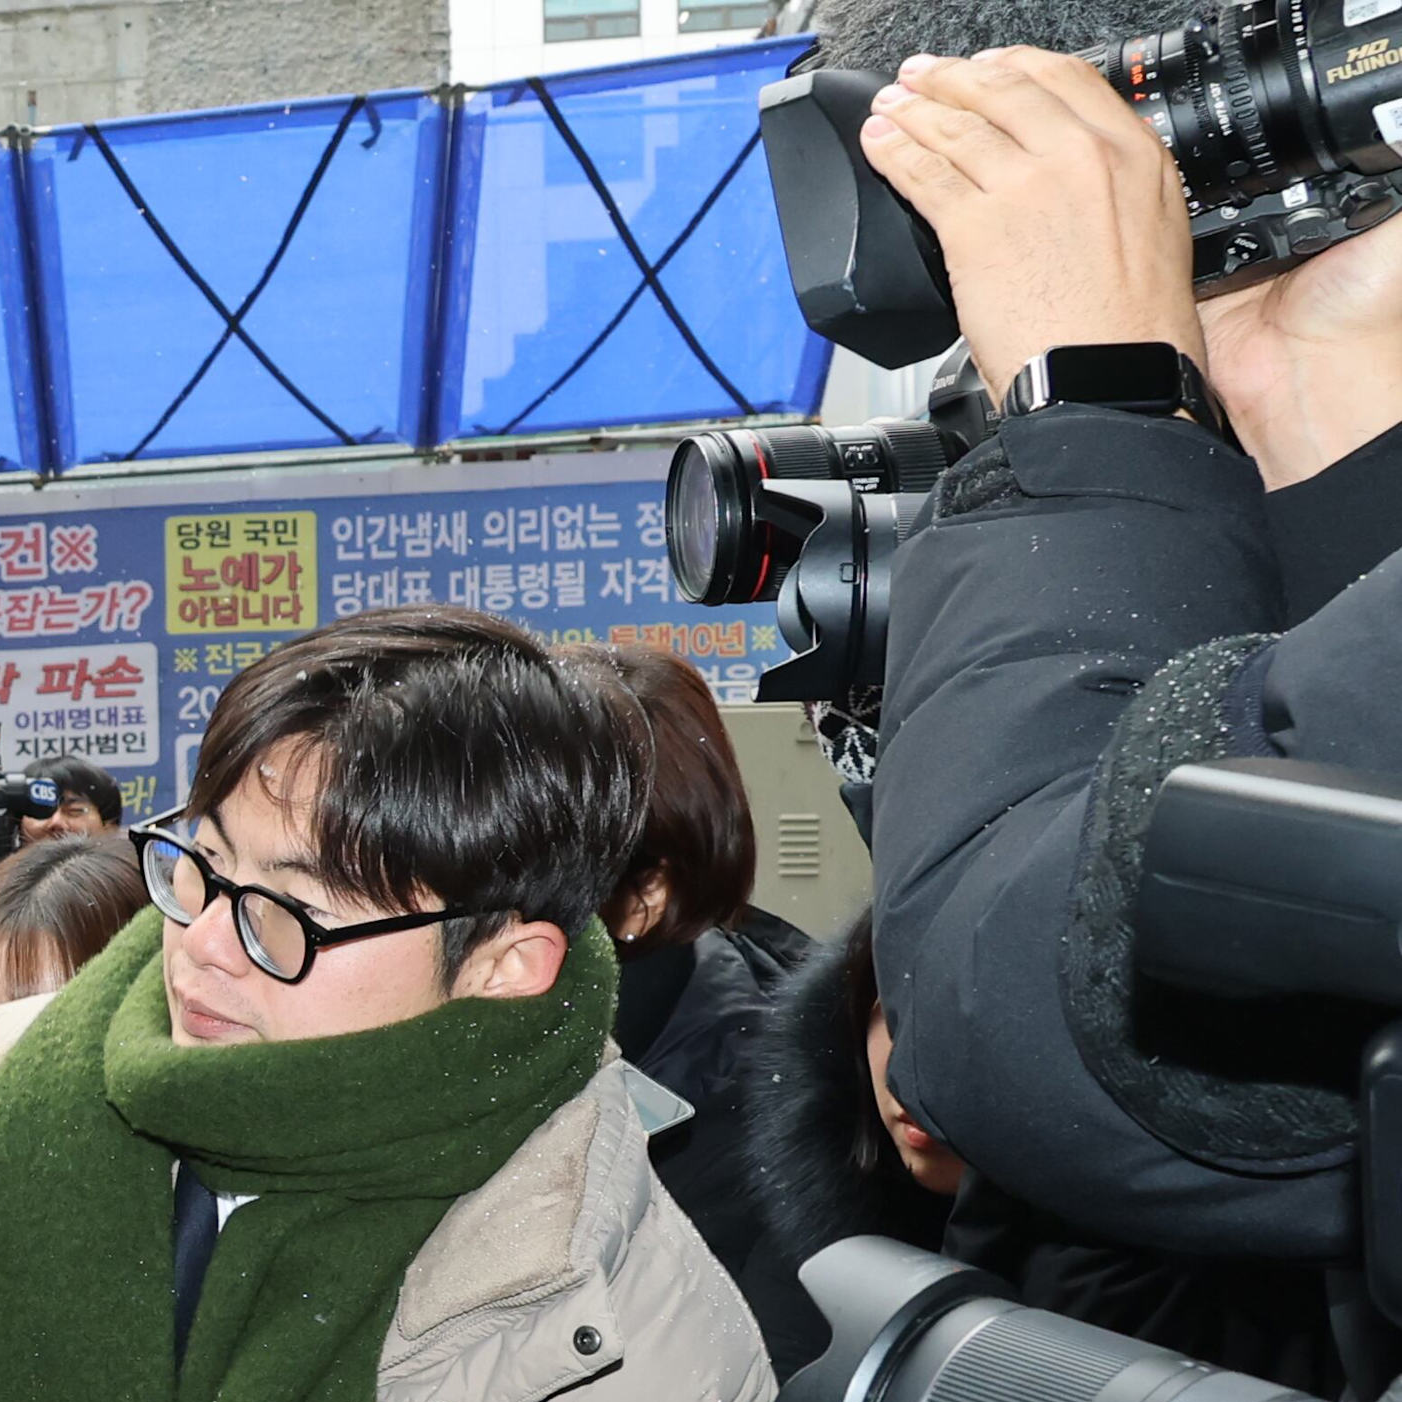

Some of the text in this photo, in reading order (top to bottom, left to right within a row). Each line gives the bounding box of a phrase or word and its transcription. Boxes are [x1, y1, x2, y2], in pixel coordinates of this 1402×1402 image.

[1326, 47, 1402, 84] FUJINO
[1347, 38, 1390, 63] HD
[177, 518, 299, 550] 당원 국민
[331, 501, 667, 561] 인간냄새 의리없는 정
[178, 551, 303, 592] 노예가
[332, 557, 684, 617] 당대표 대통령될 자격
[178, 594, 304, 628] 아닙니다
[205, 641, 282, 675] 전국
[36, 656, 144, 701] 파손
[14, 706, 147, 732] 이재명대표
[16, 731, 146, 758] 지지자범인
[30, 783, 57, 802] CBS
